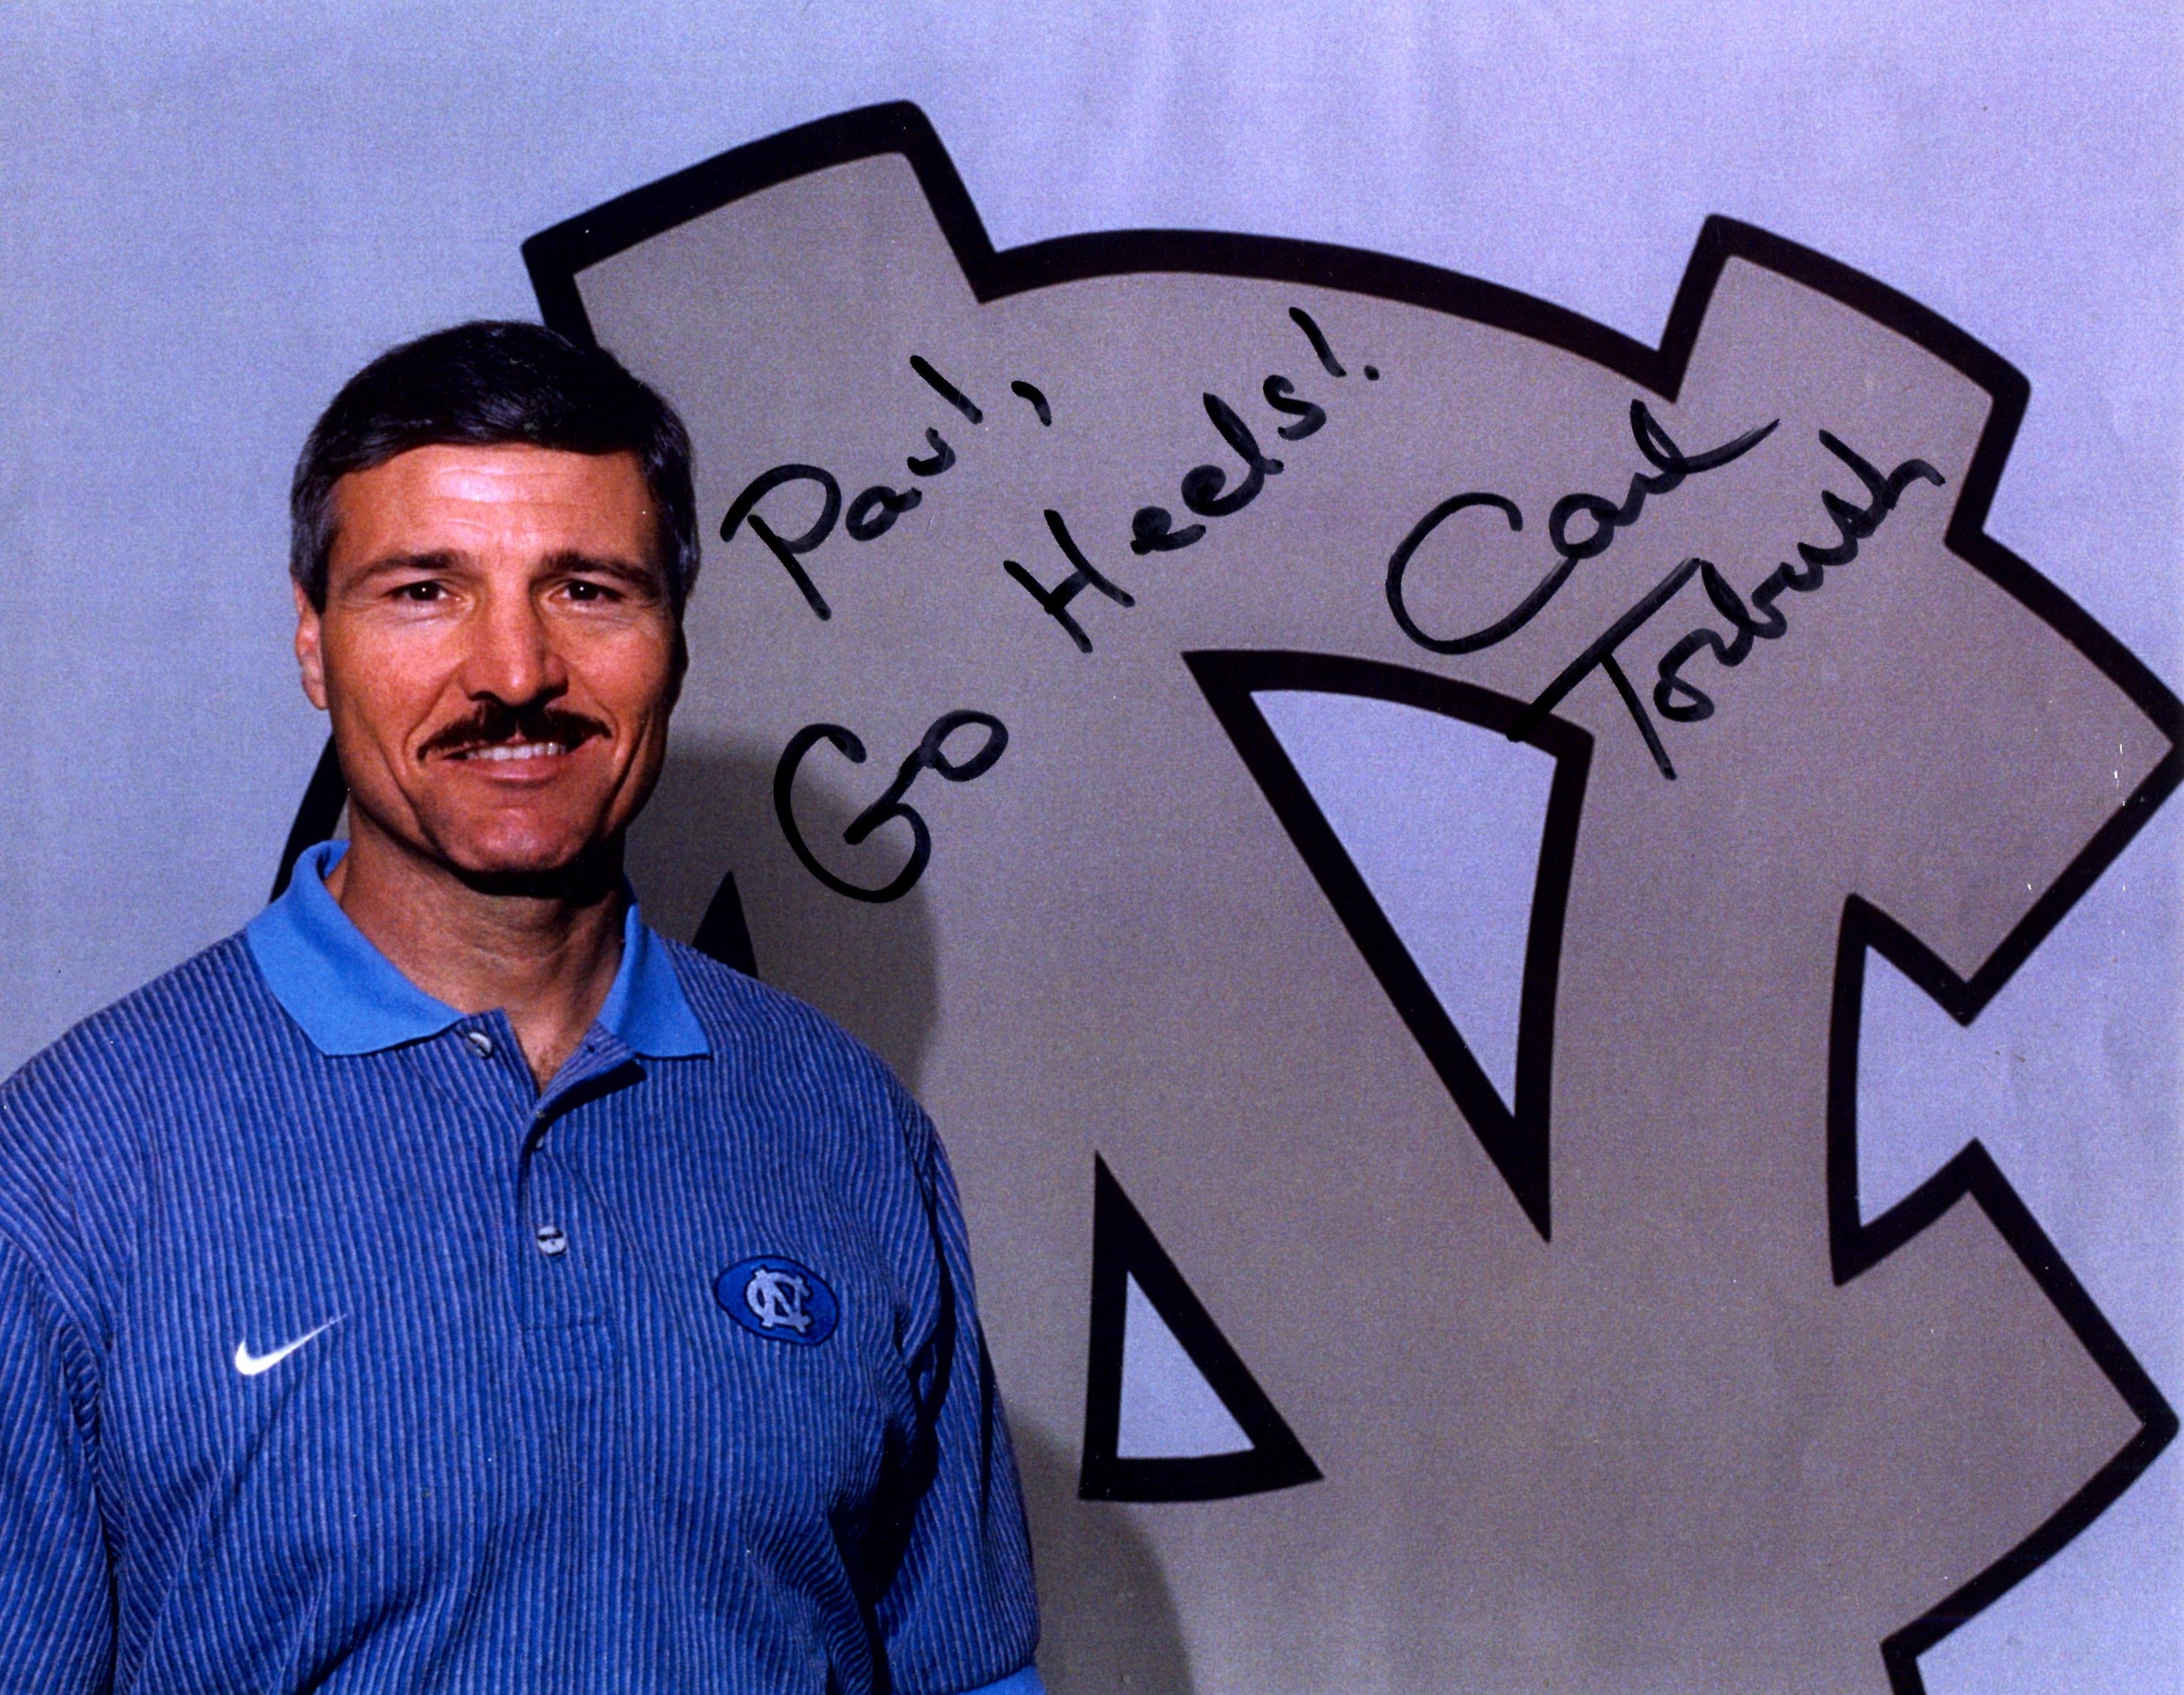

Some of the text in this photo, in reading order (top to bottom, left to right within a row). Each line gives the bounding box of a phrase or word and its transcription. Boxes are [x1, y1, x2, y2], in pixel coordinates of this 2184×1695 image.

[720, 355, 1052, 621] Paul,
[773, 307, 1381, 904] Go Heels!
